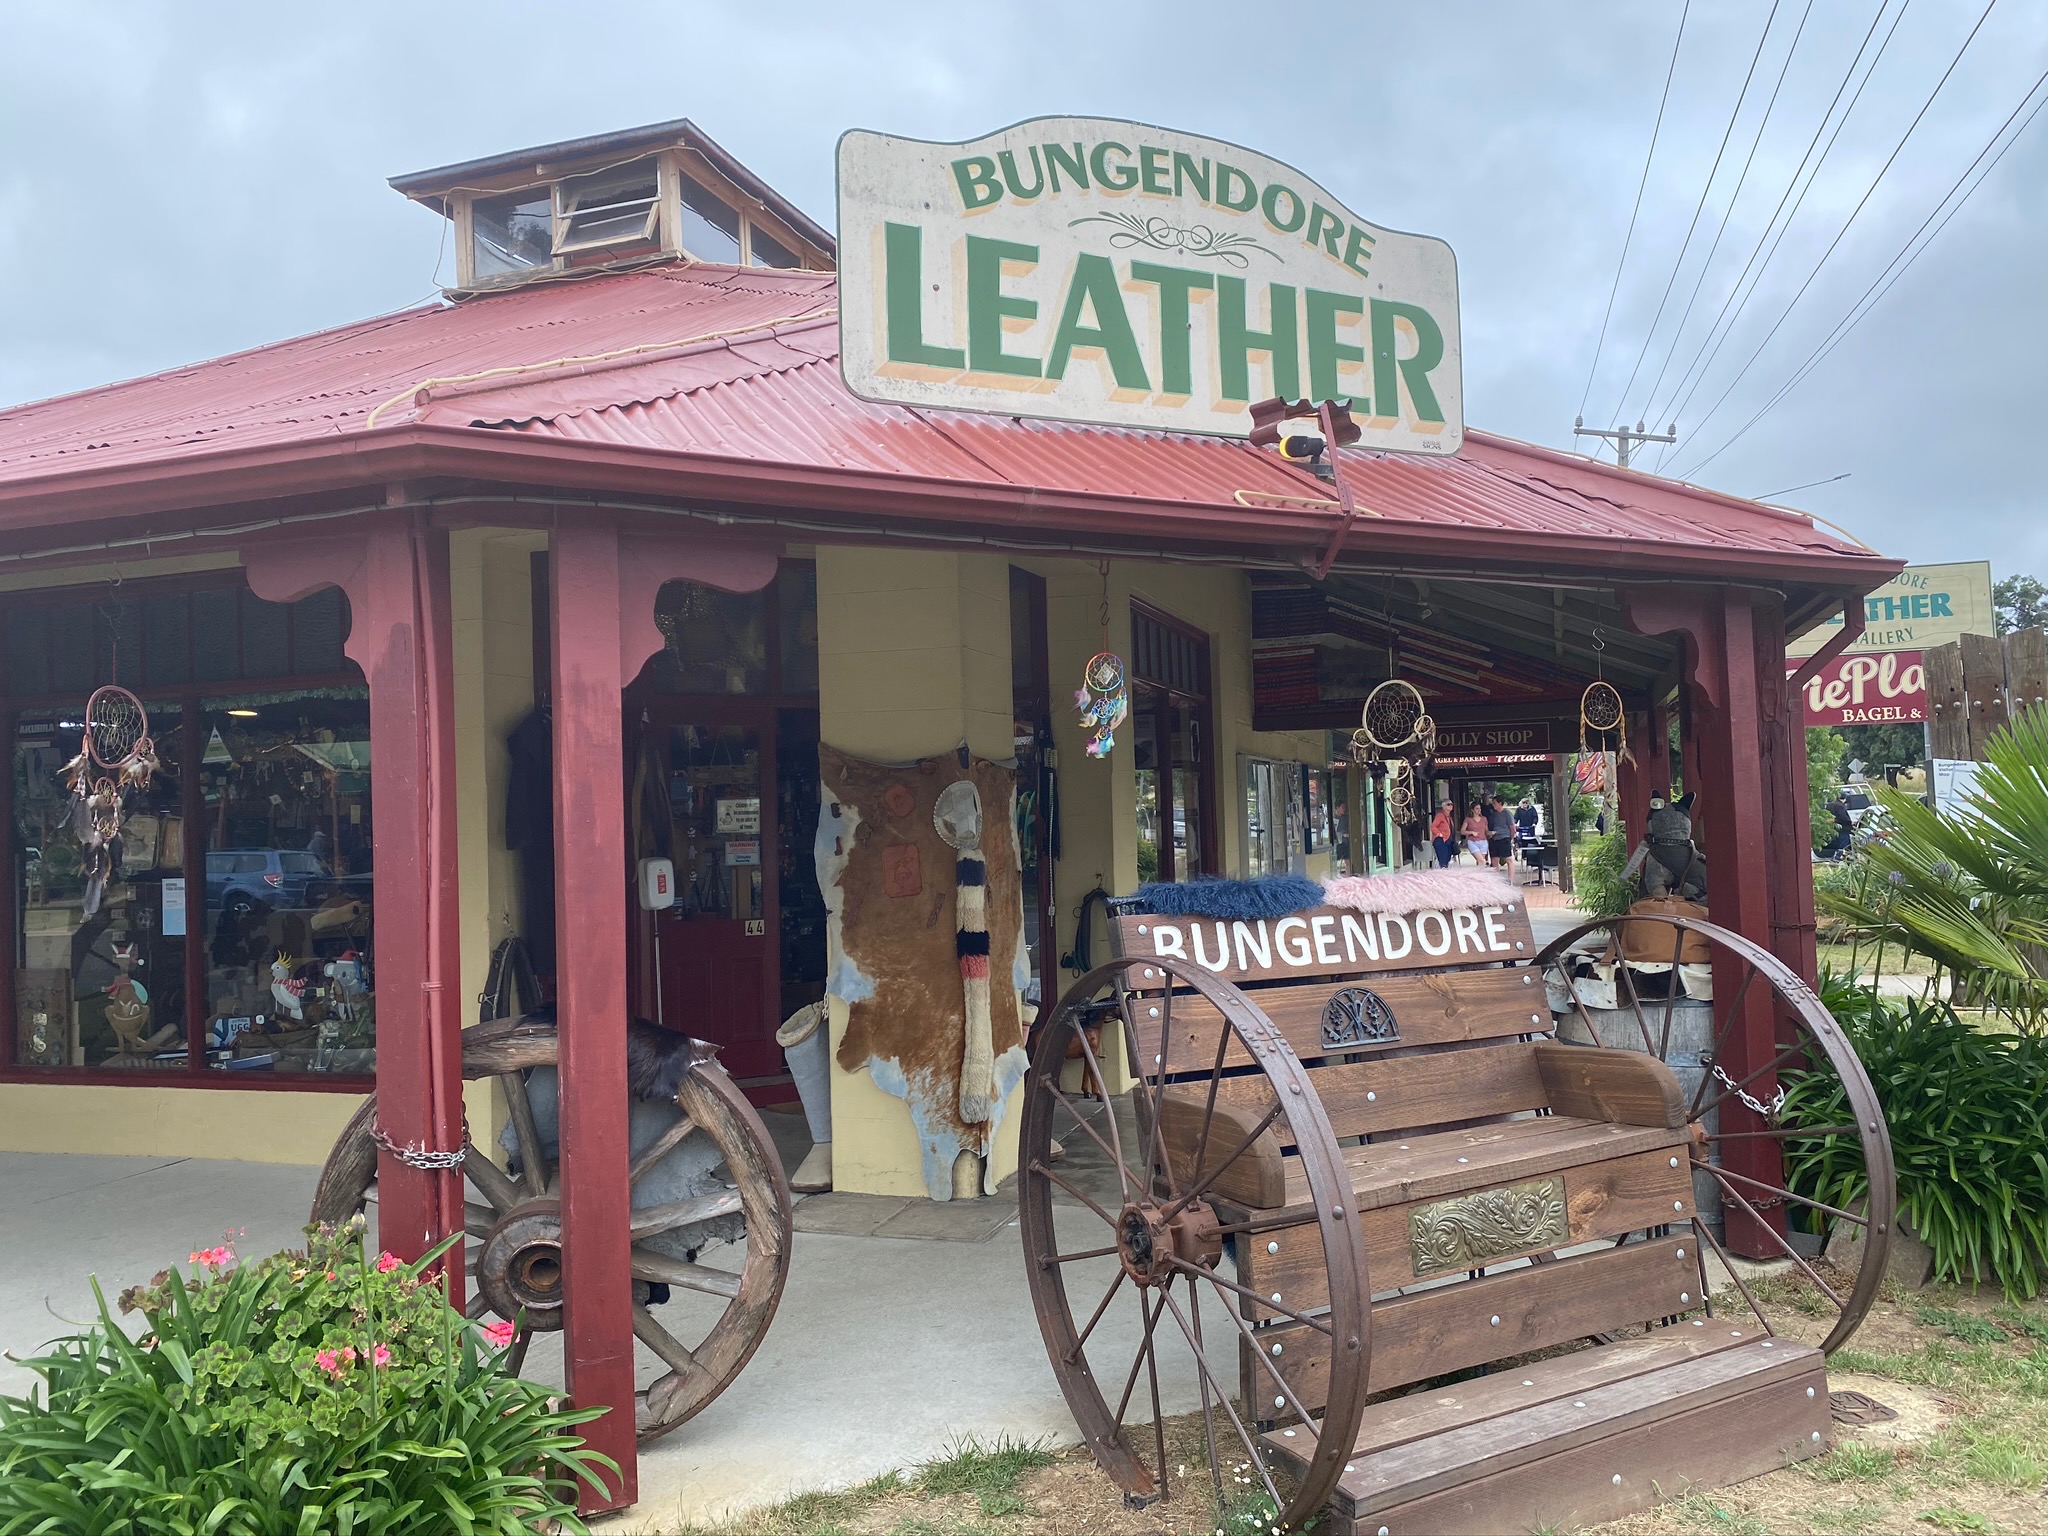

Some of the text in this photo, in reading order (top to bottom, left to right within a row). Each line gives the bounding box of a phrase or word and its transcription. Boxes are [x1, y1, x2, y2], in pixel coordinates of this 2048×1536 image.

[951, 141, 1377, 278] BUNGENDORE
[880, 221, 1446, 427] LEATHER
[1822, 592, 1954, 625] THER
[1786, 652, 1926, 713] iePla
[1841, 706, 1922, 722] BAGEL &
[1436, 729, 1534, 747] OLLY SHOP
[1459, 755, 1489, 763] BAKERY
[746, 921, 763, 935] 44
[1152, 906, 1512, 977] BUNGENDORE
